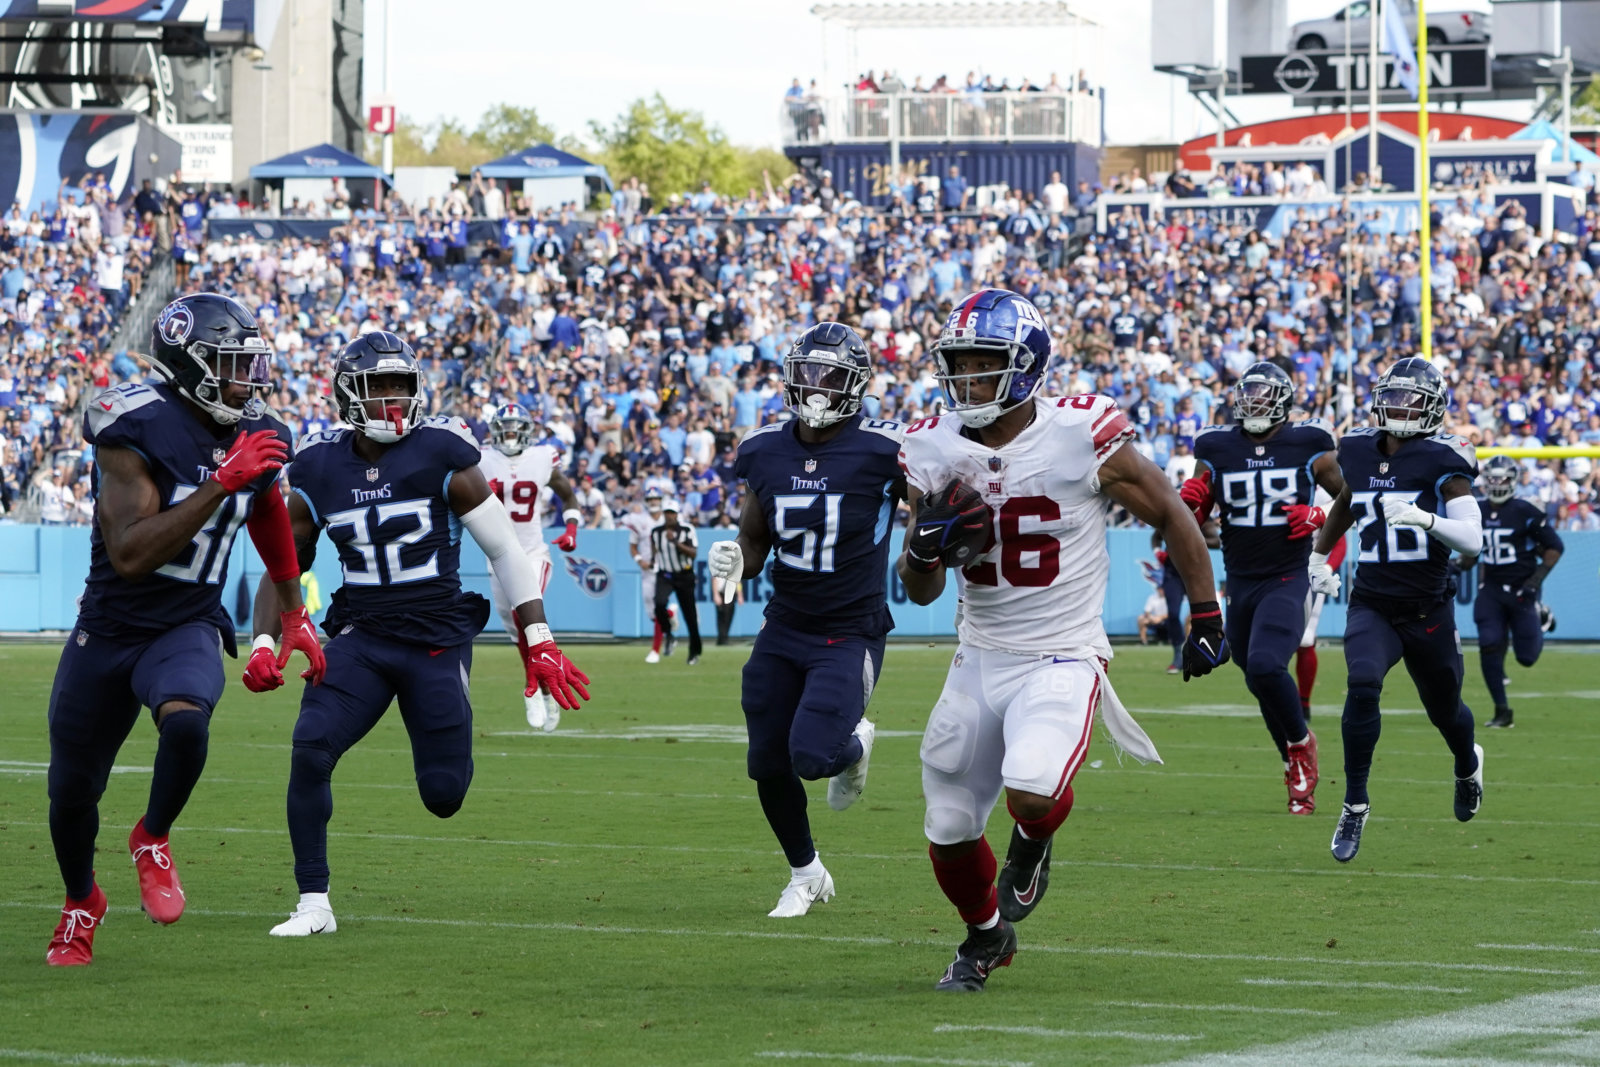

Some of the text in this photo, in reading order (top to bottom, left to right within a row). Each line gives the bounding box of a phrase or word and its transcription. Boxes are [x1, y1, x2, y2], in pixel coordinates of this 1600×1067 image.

[373, 106, 391, 132] J
[949, 311, 979, 329] 26
[351, 482, 392, 505] TITANS
[791, 475, 829, 491] TITANS
[1222, 467, 1299, 528] 98
[324, 497, 440, 586] 32
[773, 494, 845, 573] 51
[1350, 490, 1431, 563] 26
